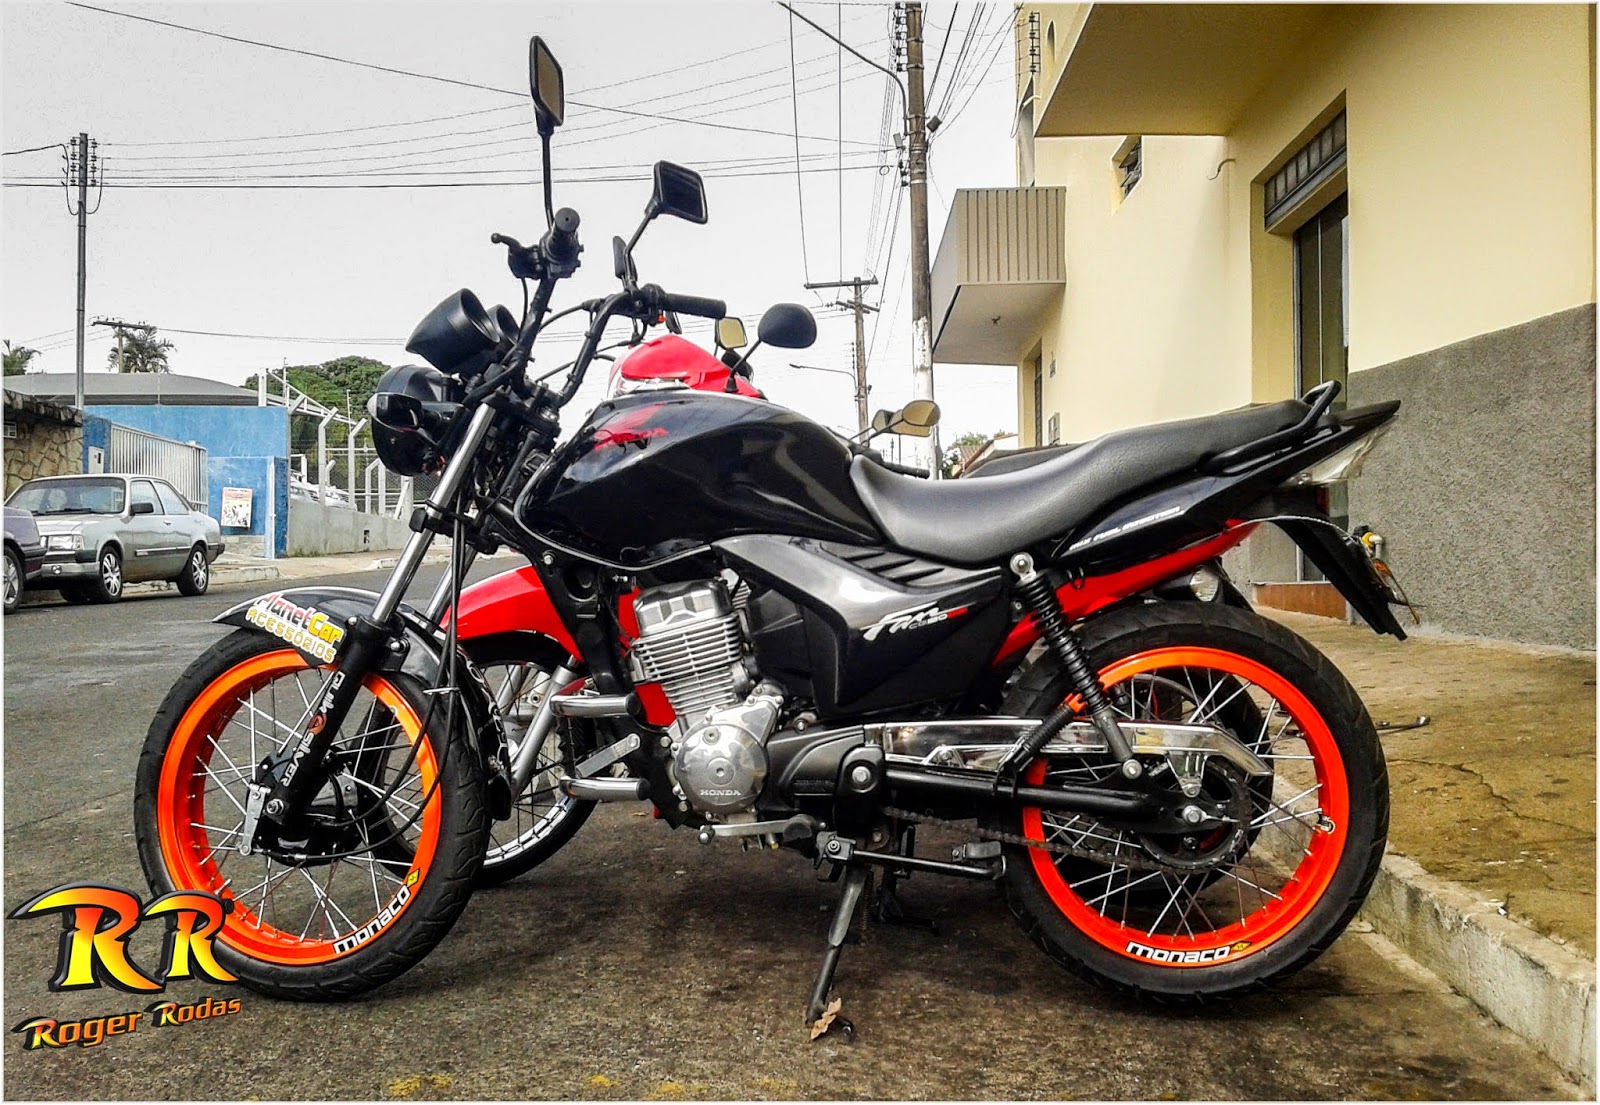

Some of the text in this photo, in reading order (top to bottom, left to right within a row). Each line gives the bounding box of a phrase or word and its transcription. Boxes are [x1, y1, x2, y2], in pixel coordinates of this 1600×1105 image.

[699, 788, 742, 797] HONDA
[332, 885, 411, 955] monaco
[1125, 941, 1231, 963] monaco
